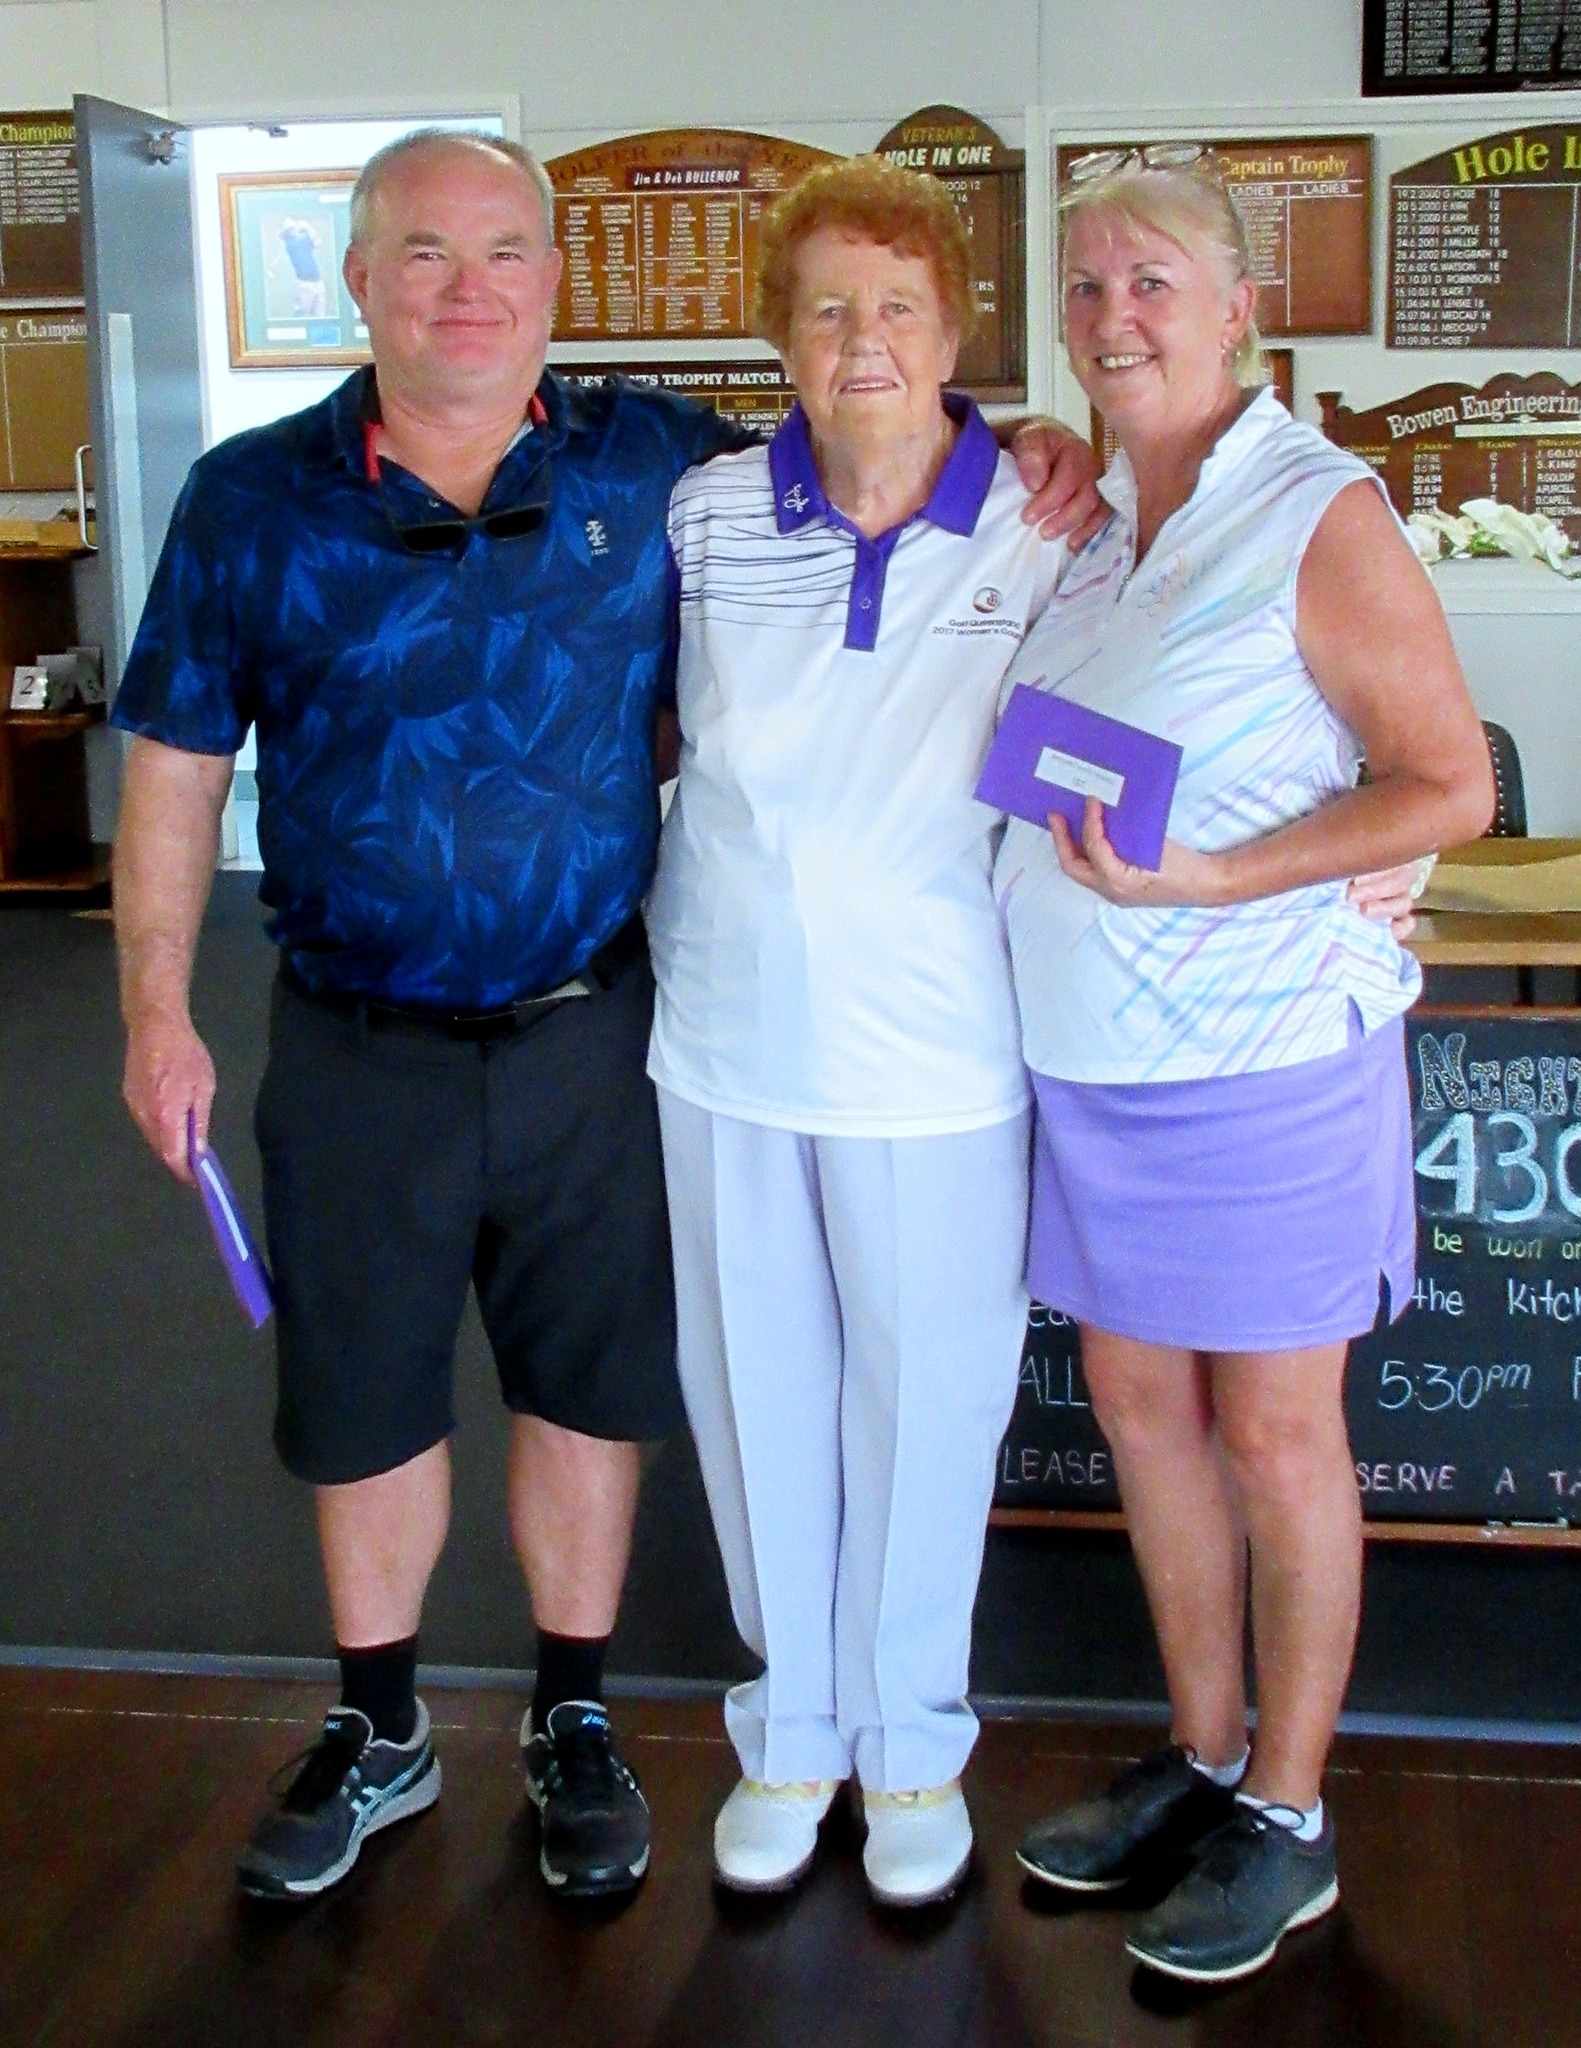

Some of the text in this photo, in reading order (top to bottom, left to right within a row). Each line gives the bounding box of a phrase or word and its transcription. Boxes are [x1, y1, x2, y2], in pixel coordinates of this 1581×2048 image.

[884, 145, 993, 167] HOLE IN ONE
[1289, 154, 1349, 178] Trophy
[1453, 136, 1581, 183] Hole I
[634, 172, 651, 186] Jim
[653, 171, 662, 184] &
[970, 180, 981, 190] 12
[1303, 183, 1349, 195] LADIES
[1228, 185, 1274, 197] LADIES
[662, 372, 724, 386] TROPHY
[727, 371, 781, 385] MATCH
[1386, 389, 1581, 440] Bowen Engineerin
[1549, 459, 1577, 470] KING
[19, 675, 35, 695] 2
[1434, 1226, 1464, 1253] be
[1489, 1238, 1542, 1260] won
[1411, 1277, 1465, 1316] the
[1495, 1466, 1516, 1495] A
